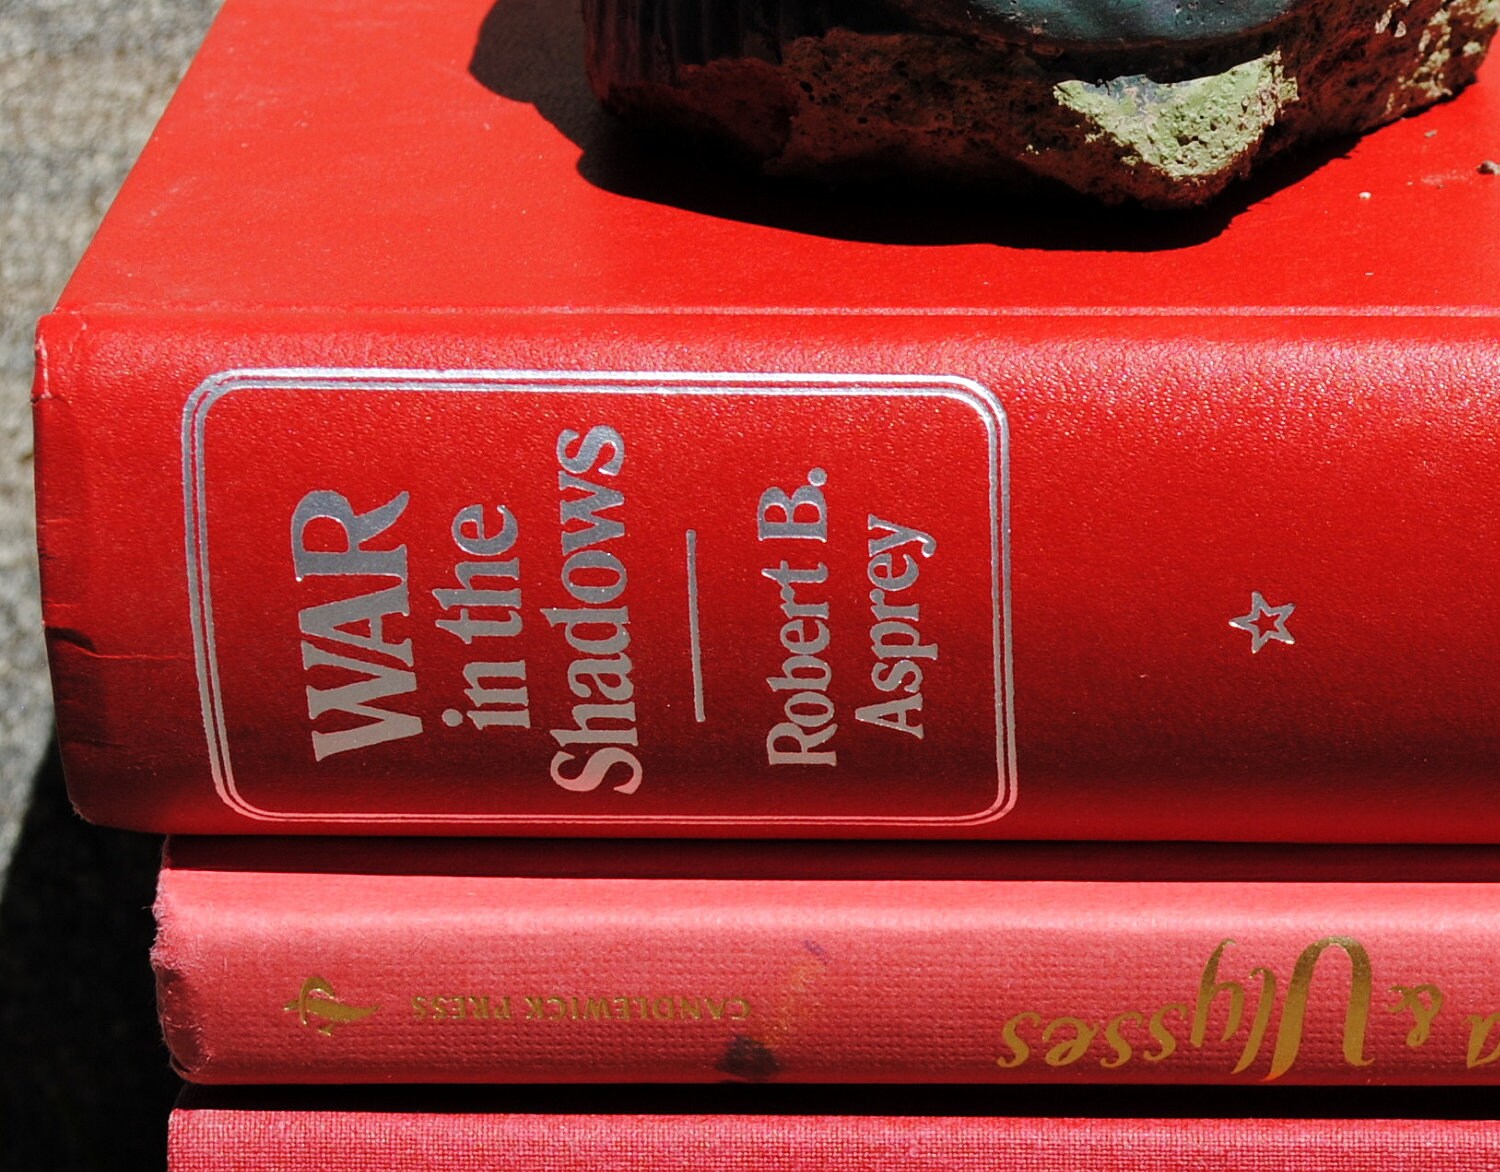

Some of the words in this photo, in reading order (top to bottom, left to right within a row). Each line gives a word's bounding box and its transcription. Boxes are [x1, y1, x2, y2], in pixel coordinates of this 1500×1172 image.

[432, 504, 529, 645] the
[756, 466, 828, 543] B.
[291, 489, 423, 762] WAR
[540, 425, 643, 796] Shadows
[760, 559, 838, 767] Robert
[855, 514, 938, 738] Asprey
[443, 659, 530, 732] in
[411, 995, 510, 1020] PRESS
[525, 995, 751, 1020] CANDLEWICK
[998, 936, 1375, 1082] Ulysses
[1389, 983, 1444, 1046] &
